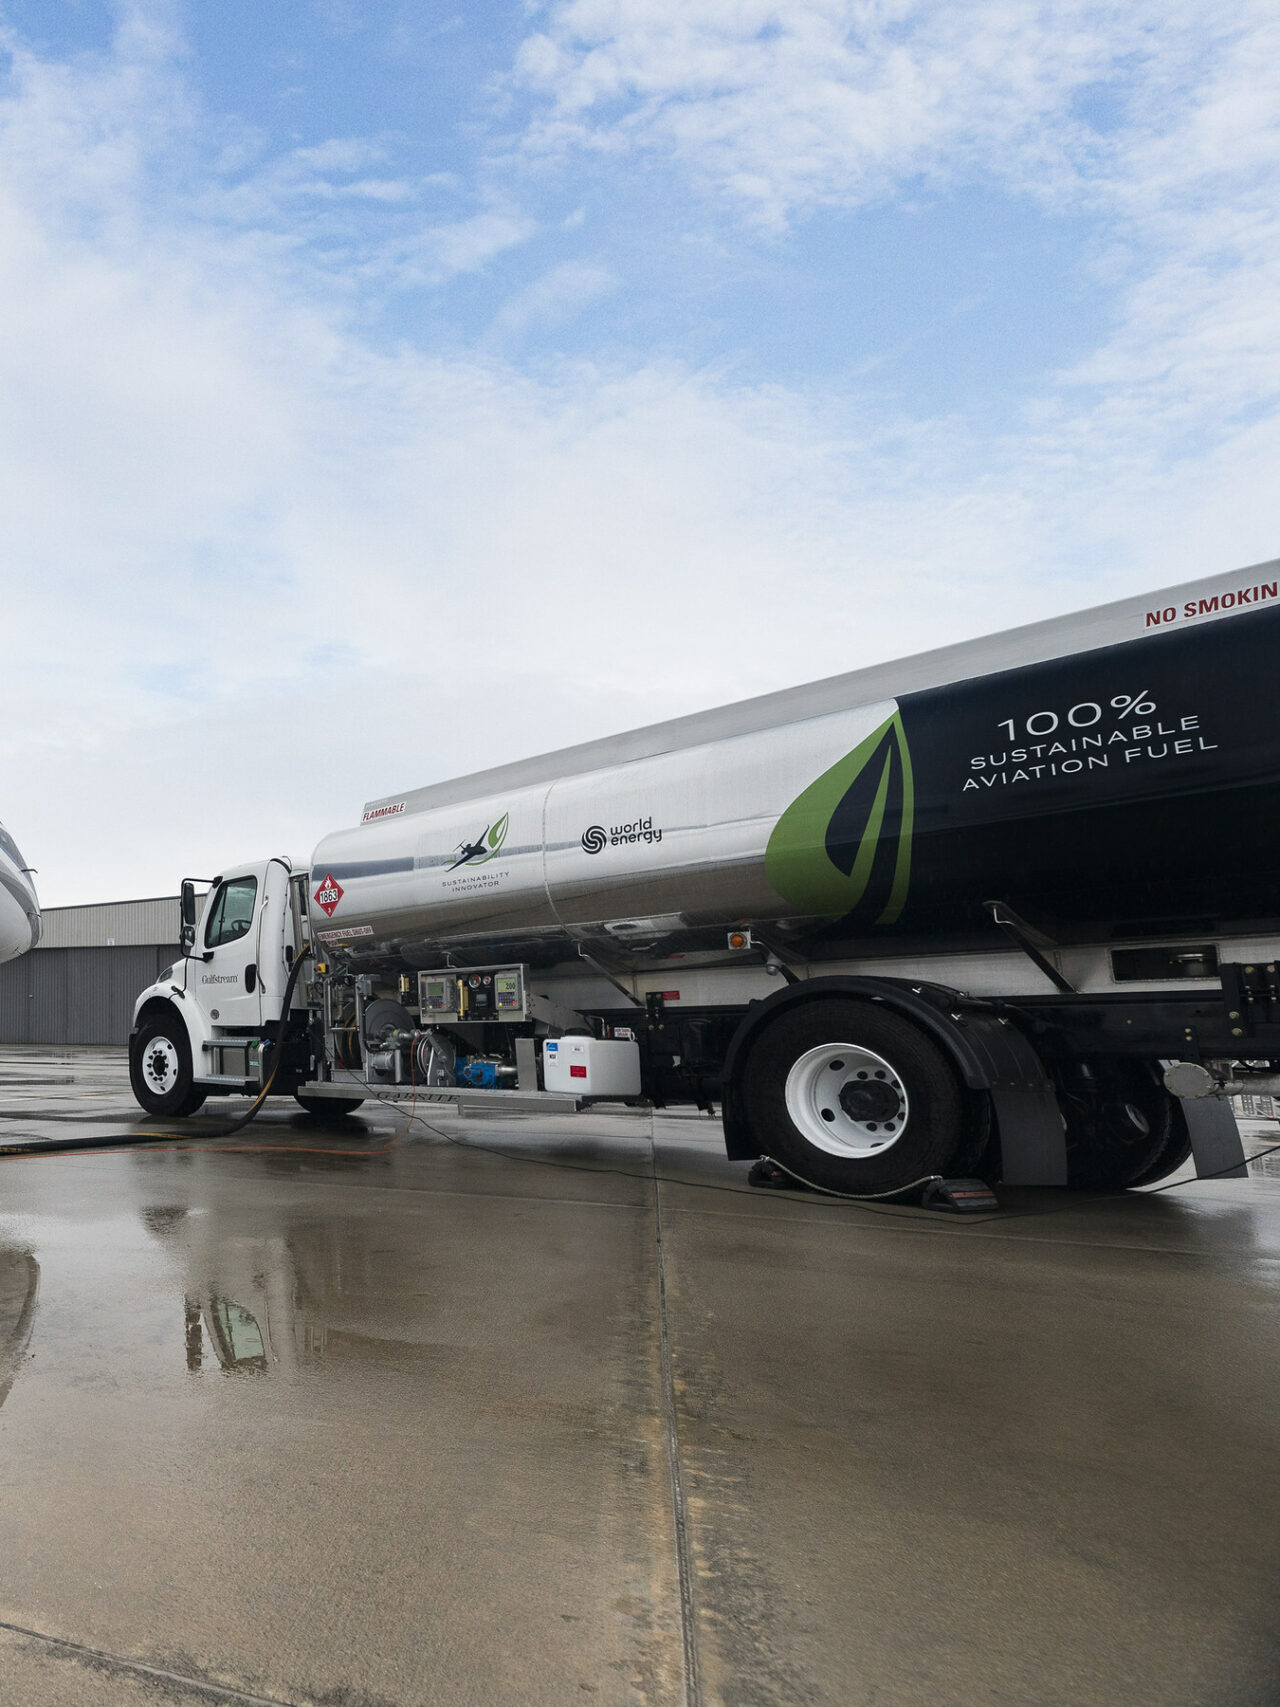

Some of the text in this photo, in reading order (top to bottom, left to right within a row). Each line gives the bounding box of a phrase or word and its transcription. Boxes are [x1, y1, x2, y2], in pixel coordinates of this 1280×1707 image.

[1146, 581, 1280, 627] NO SMOKIN
[998, 690, 1157, 741] 100%
[970, 715, 1200, 770] SUSTAINABLE
[962, 736, 1218, 792] AVIATION FUEL
[362, 802, 405, 821] FLAMMABLE
[610, 816, 652, 836] world
[611, 829, 662, 846] energy
[442, 872, 510, 887] SUSTAINABILITY
[452, 881, 499, 892] INNOVATOR
[320, 889, 338, 903] 1863
[202, 975, 238, 984] Gulfstream
